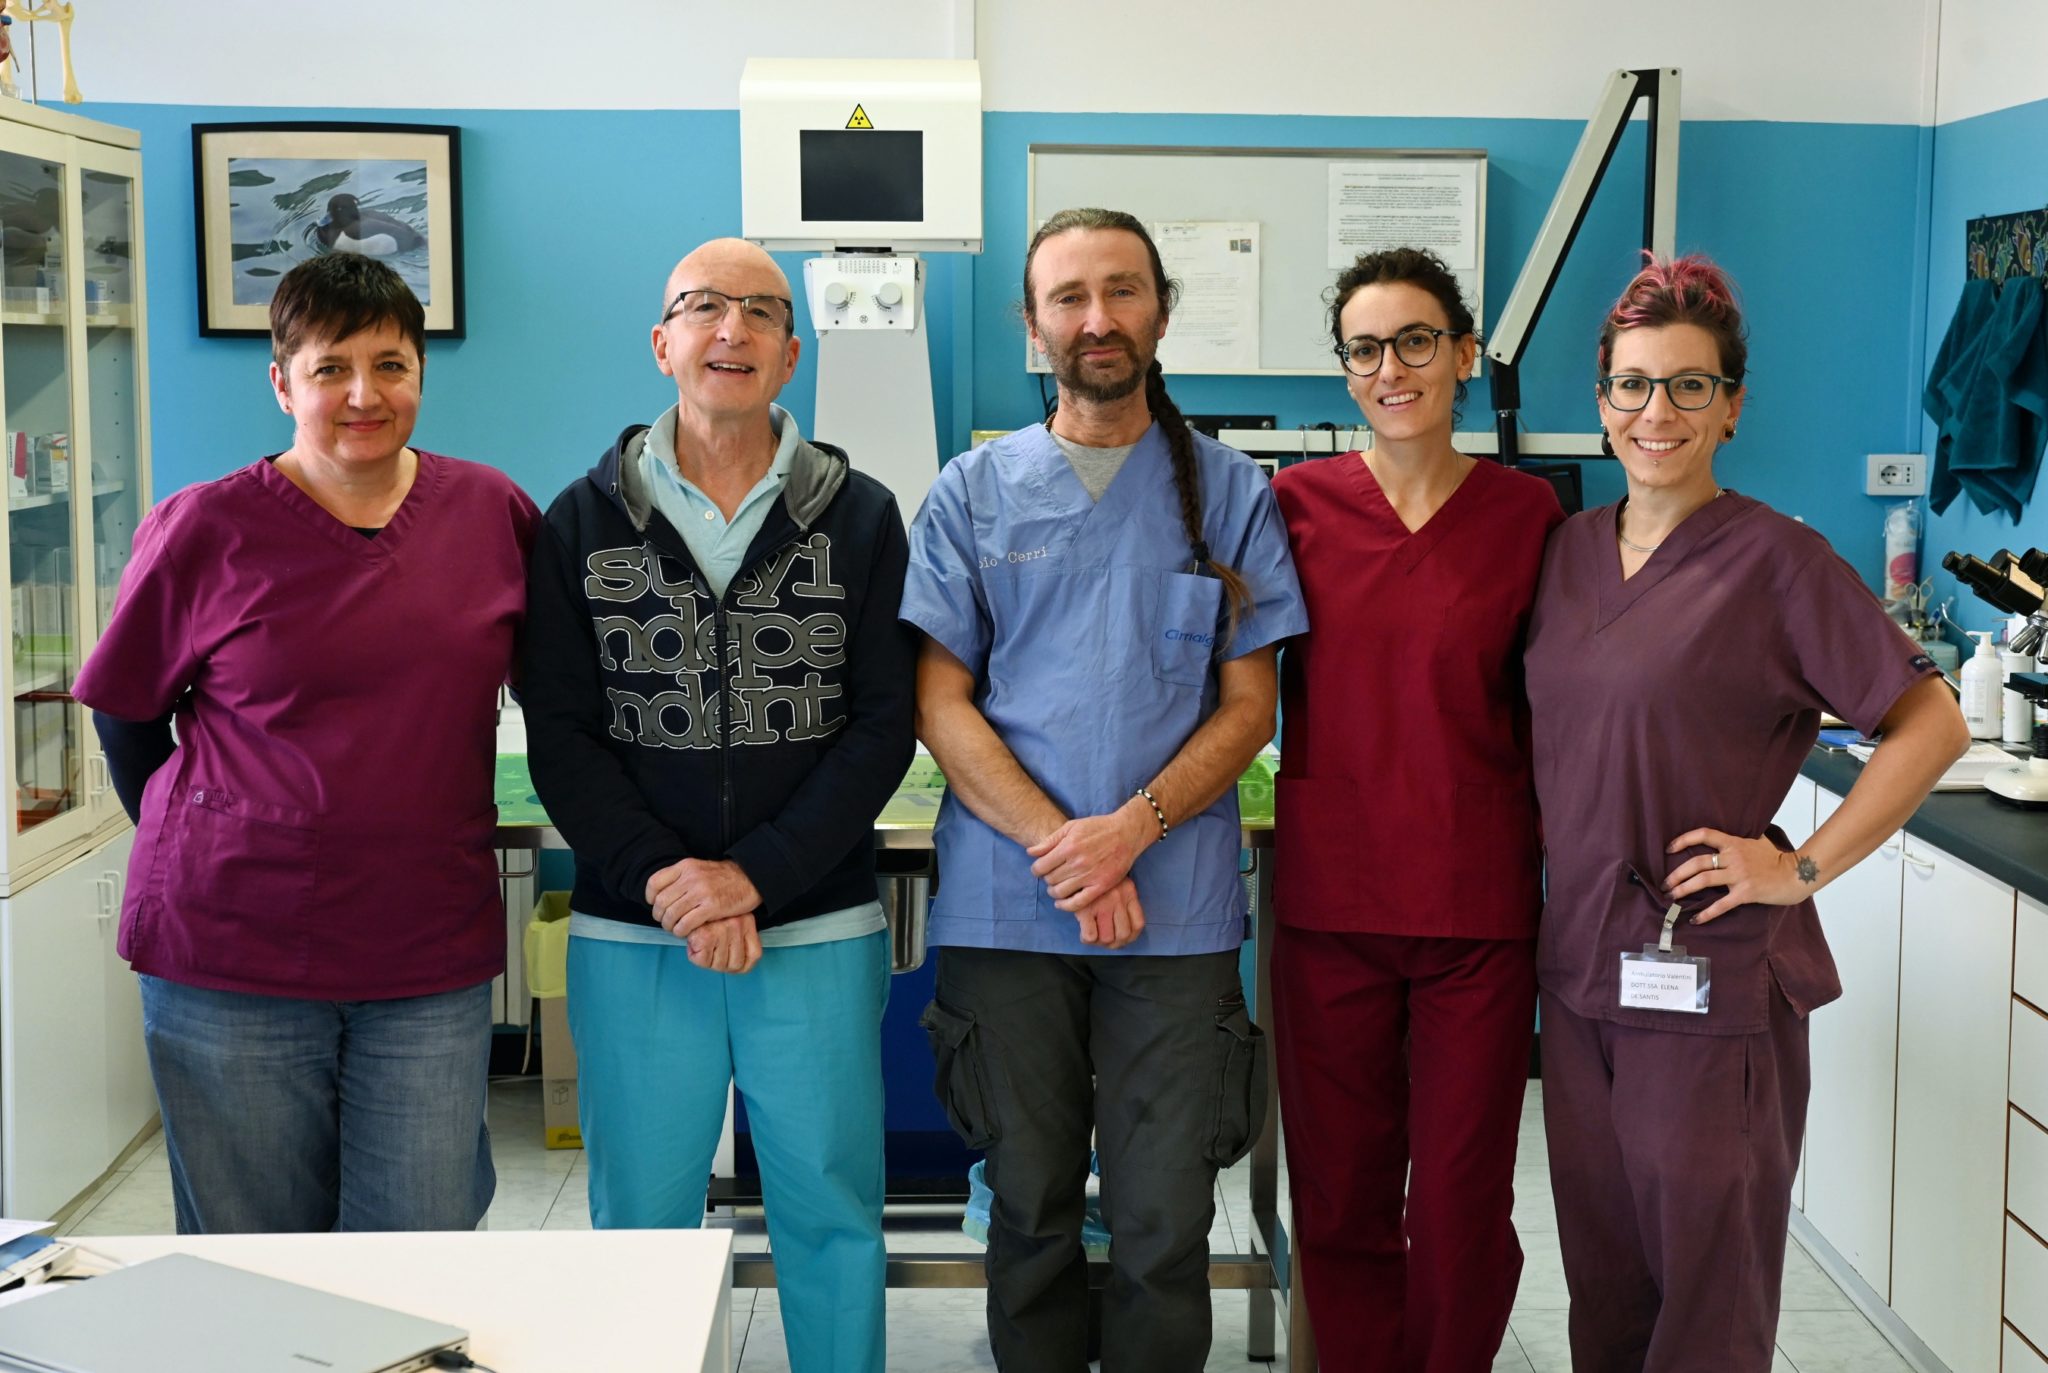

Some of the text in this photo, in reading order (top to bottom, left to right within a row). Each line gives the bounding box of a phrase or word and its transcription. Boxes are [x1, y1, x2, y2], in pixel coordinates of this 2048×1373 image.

[585, 533, 845, 608] styi
[1008, 546, 1047, 563] Cerri
[606, 672, 847, 750] ndent
